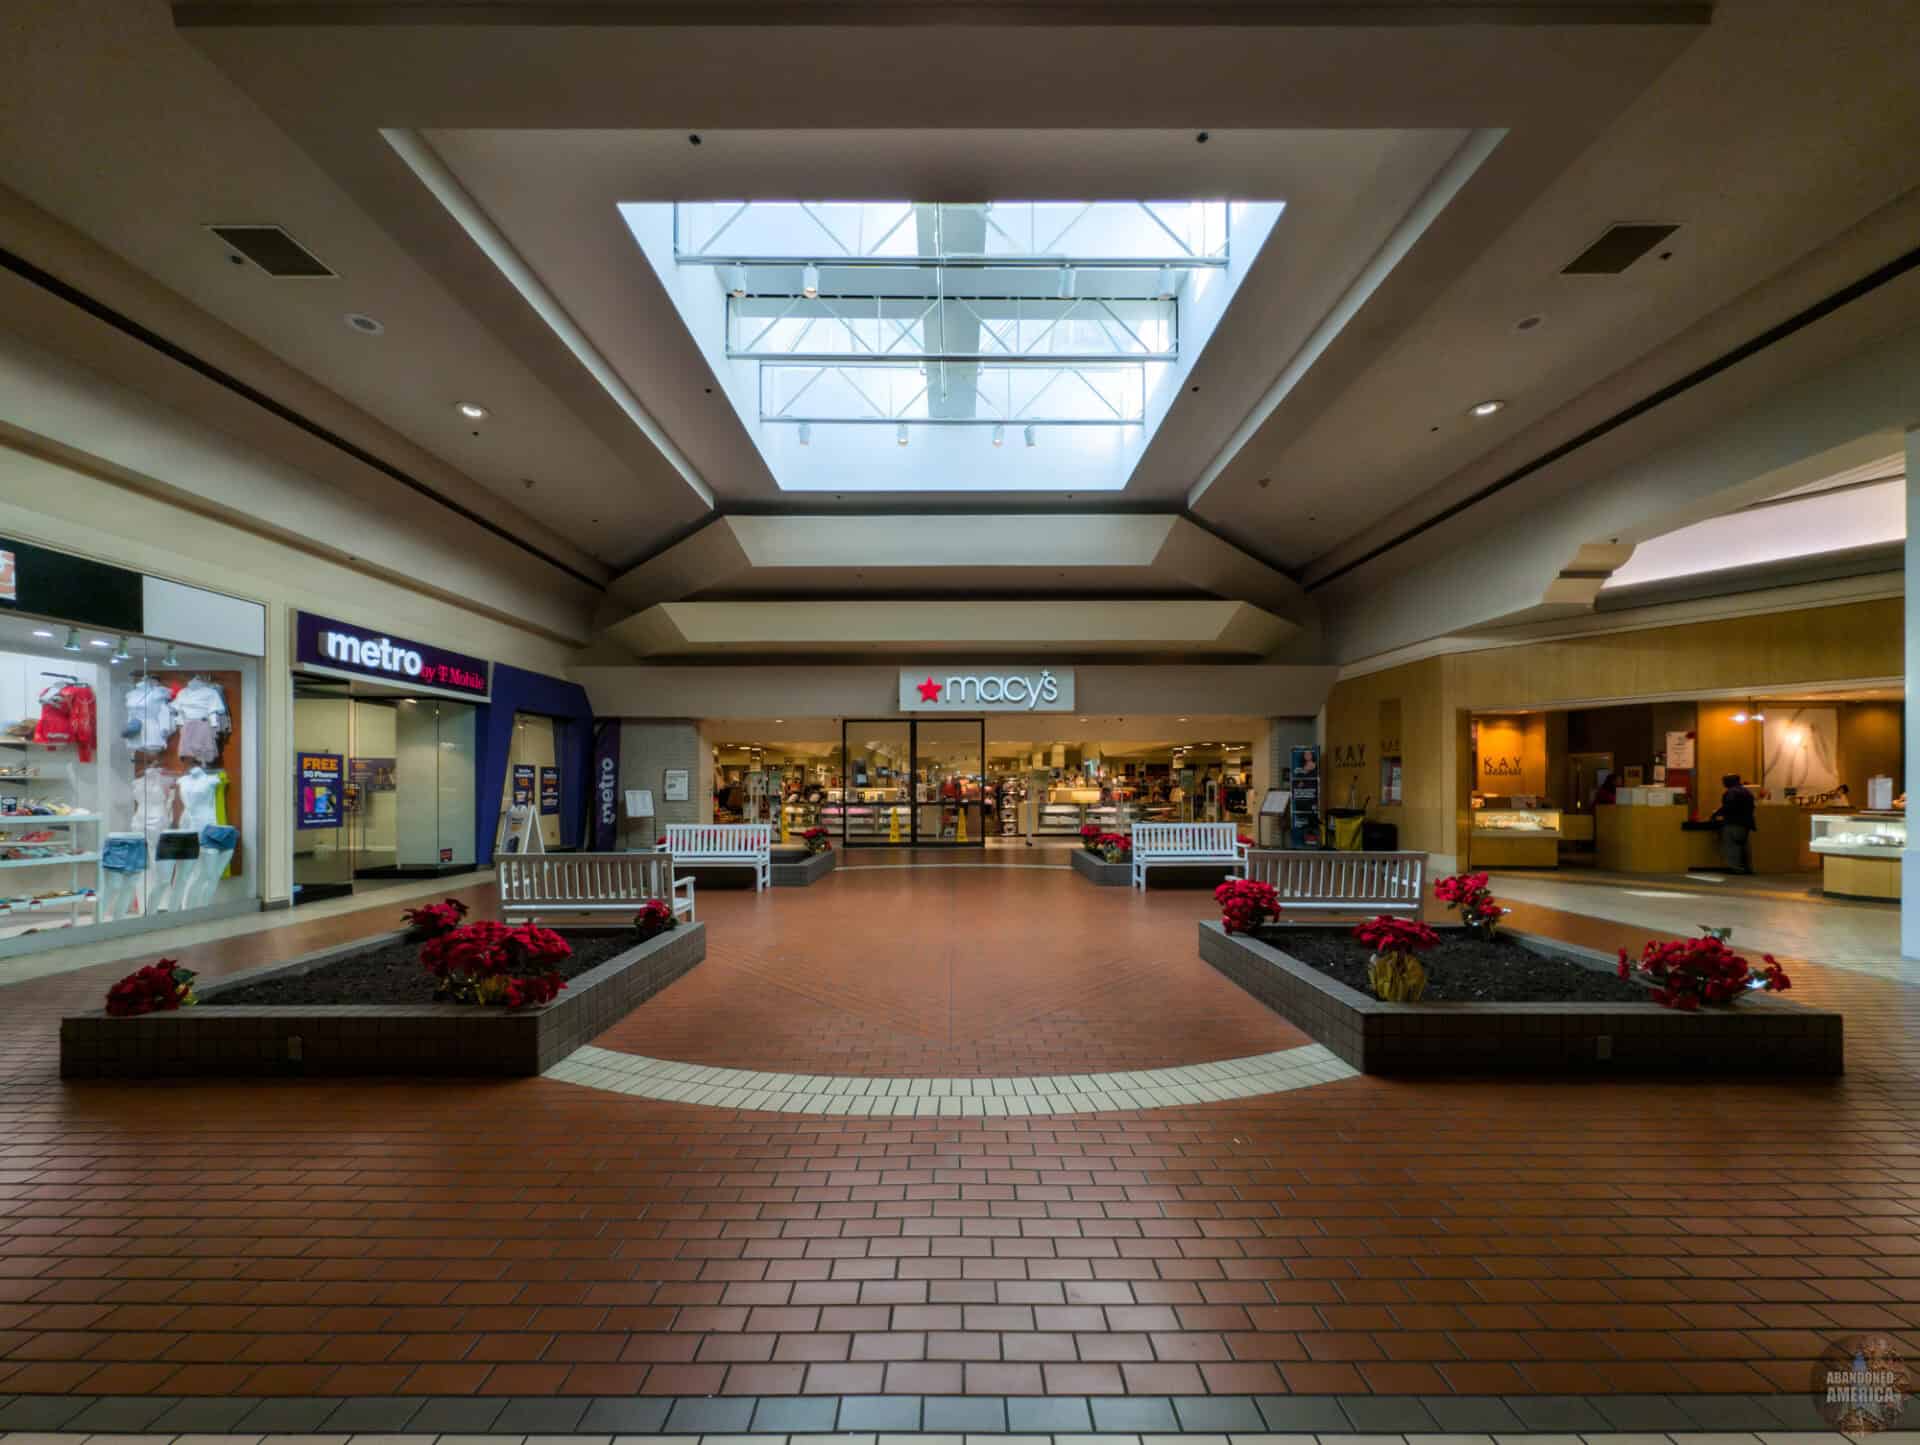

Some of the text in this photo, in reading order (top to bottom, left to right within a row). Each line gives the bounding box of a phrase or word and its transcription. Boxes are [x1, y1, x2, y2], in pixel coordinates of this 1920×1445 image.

[326, 631, 422, 676] metro
[303, 757, 338, 771] FREE
[1483, 756, 1521, 769] KAY
[599, 757, 616, 824] metro
